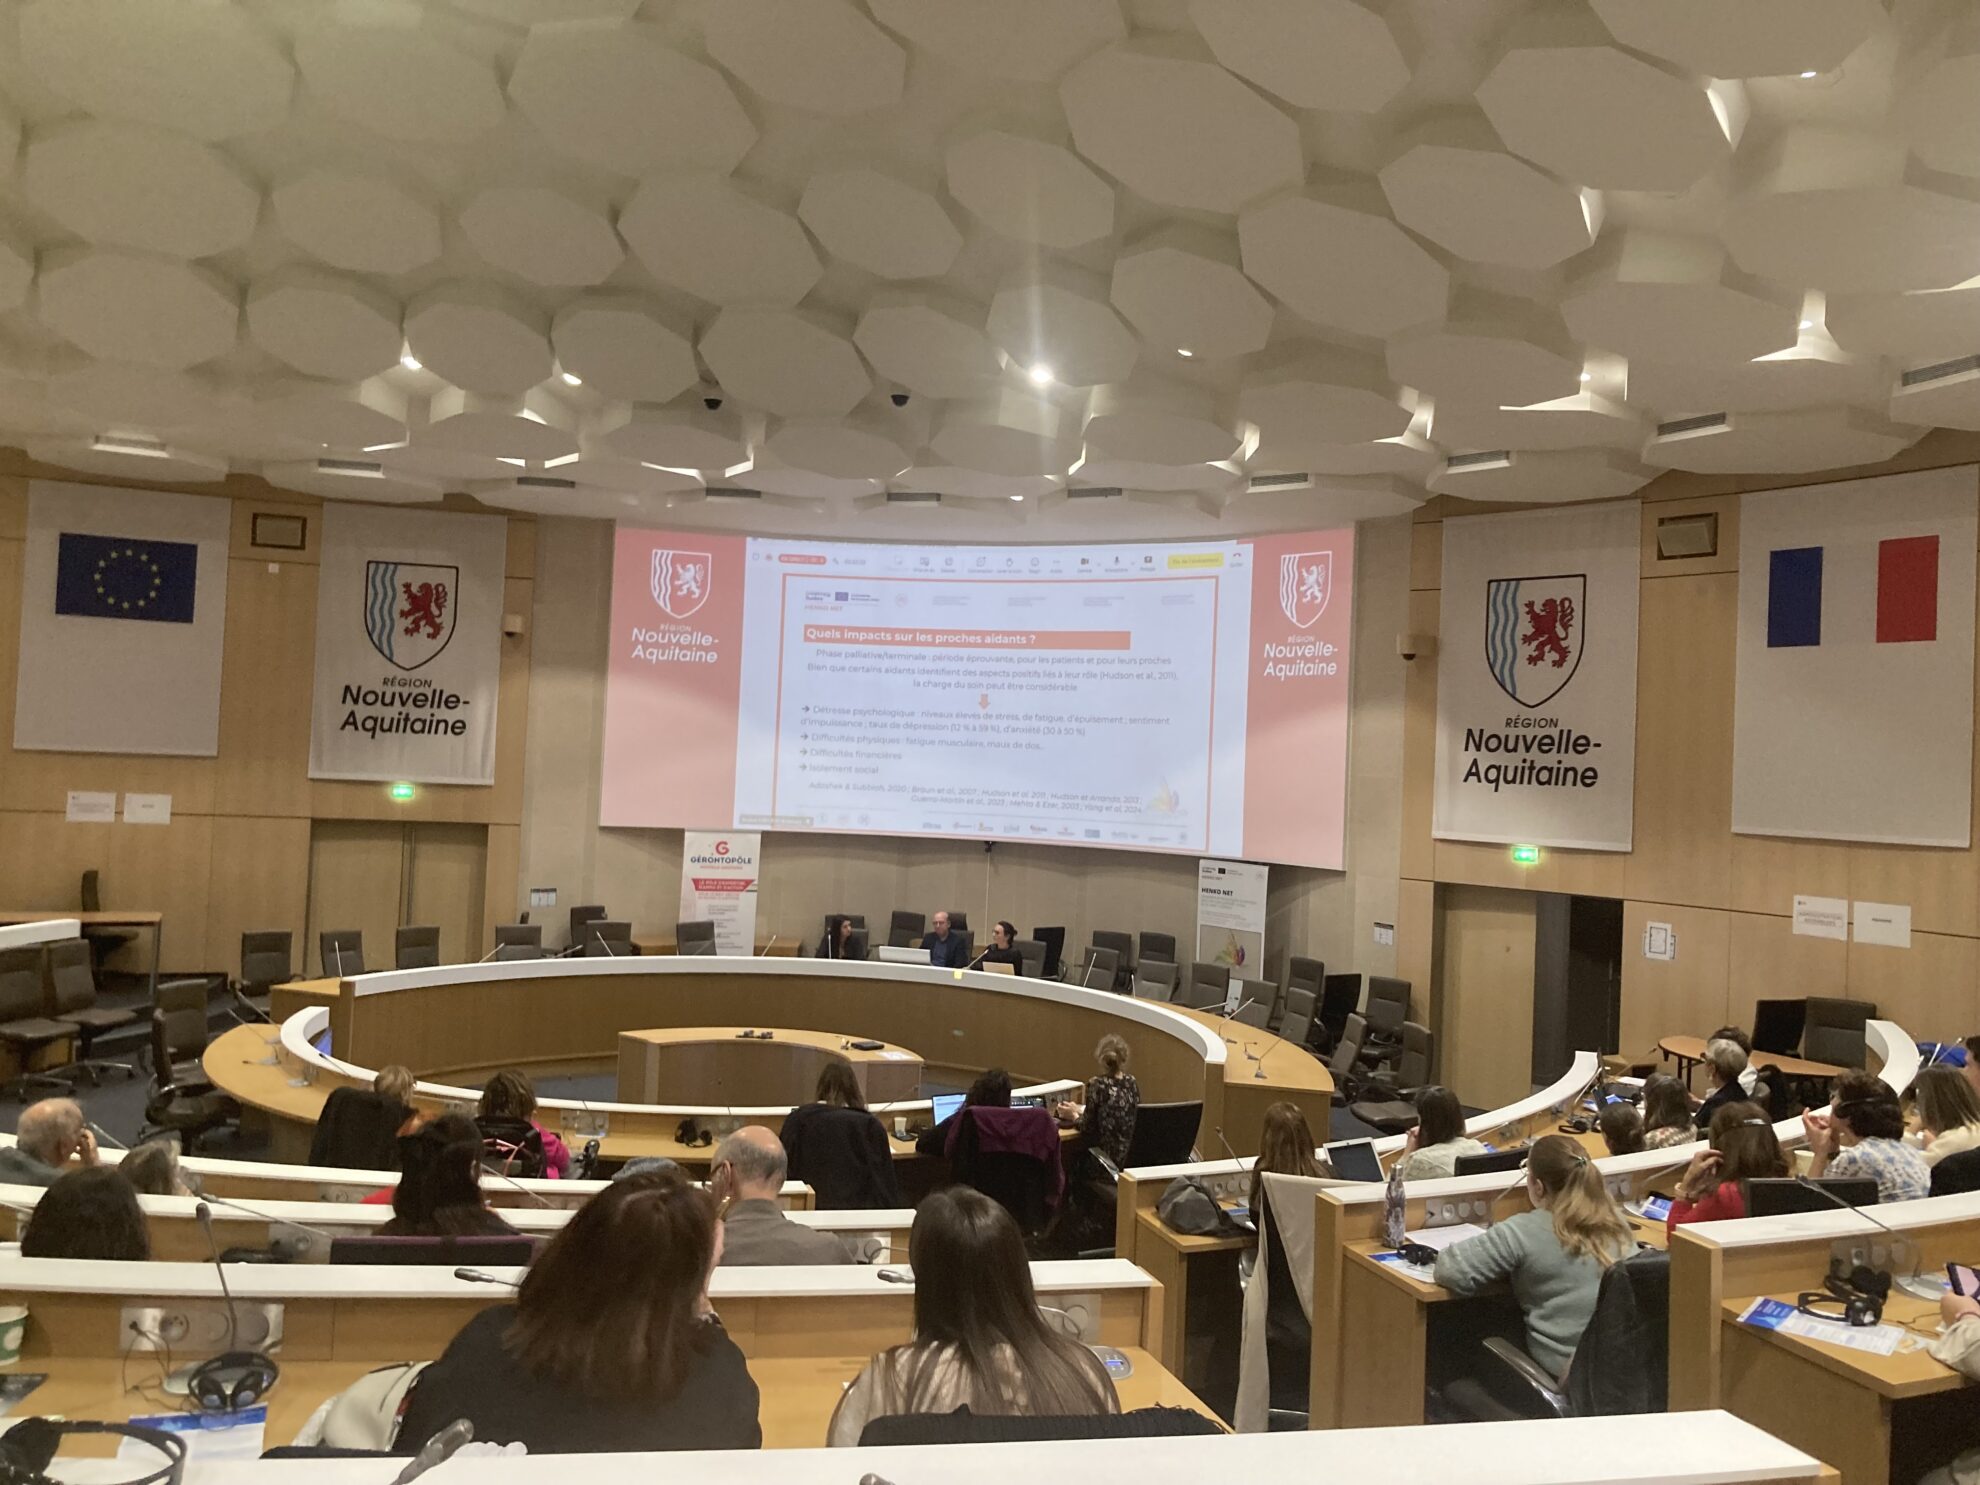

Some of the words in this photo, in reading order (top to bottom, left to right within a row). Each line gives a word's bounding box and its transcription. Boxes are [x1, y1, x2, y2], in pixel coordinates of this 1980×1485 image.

[632, 628, 719, 646] Nouvelle-
[806, 628, 841, 640] Quels
[844, 630, 892, 643] impacts
[894, 632, 913, 642] sur
[916, 630, 932, 642] les
[935, 631, 982, 646] proches
[984, 633, 1027, 644] aidants
[1029, 634, 1036, 645] ?
[631, 645, 718, 664] Aquitaine
[816, 649, 843, 658] Phase
[932, 653, 964, 663] période
[1017, 657, 1036, 666] pour
[1038, 656, 1050, 664] les
[1051, 656, 1085, 666] patients
[1096, 658, 1116, 666] pour
[1118, 656, 1138, 666] leurs
[1139, 656, 1172, 667] proches
[1264, 642, 1338, 658] Nouvelle-
[808, 663, 827, 672] Bien
[829, 666, 846, 675] que
[848, 664, 882, 674] certains
[884, 666, 916, 675] aidants
[917, 666, 961, 677] identifient
[962, 669, 978, 677] des
[979, 670, 1010, 680] aspects
[1012, 669, 1041, 680] positifs
[1064, 670, 1080, 680] leur
[1082, 670, 1098, 680] rôle
[1100, 671, 1133, 681] (Hudson
[1135, 672, 1144, 680] et
[1264, 659, 1337, 682] Aquitaine
[382, 676, 432, 688] RÉGION
[913, 680, 921, 688] la
[922, 680, 952, 690] charge
[953, 680, 964, 689] du
[966, 681, 984, 690] soin
[986, 682, 1005, 692] peut
[1007, 682, 1024, 690] être
[1025, 682, 1078, 692] considérable
[342, 685, 470, 710] Nouvelle-
[813, 705, 851, 714] Détresse
[852, 706, 915, 718] psychologique
[921, 710, 953, 719] niveaux
[982, 712, 994, 720] de
[1022, 713, 1033, 722] de
[1128, 716, 1170, 725] sentiment
[1504, 714, 1558, 728] RÉGION
[340, 710, 467, 740] Aquitaine
[869, 720, 888, 729] taux
[889, 720, 900, 730] de
[902, 722, 949, 732] dépression
[811, 733, 856, 743] Difficultés
[857, 734, 900, 745] physiques
[906, 736, 936, 747] fatigue
[987, 742, 1011, 750] maux
[1013, 740, 1023, 750] de
[1464, 728, 1602, 756] Nouvelle-
[809, 763, 852, 774] Isolement
[854, 764, 878, 774] social
[1463, 758, 1598, 792] Aquitaine
